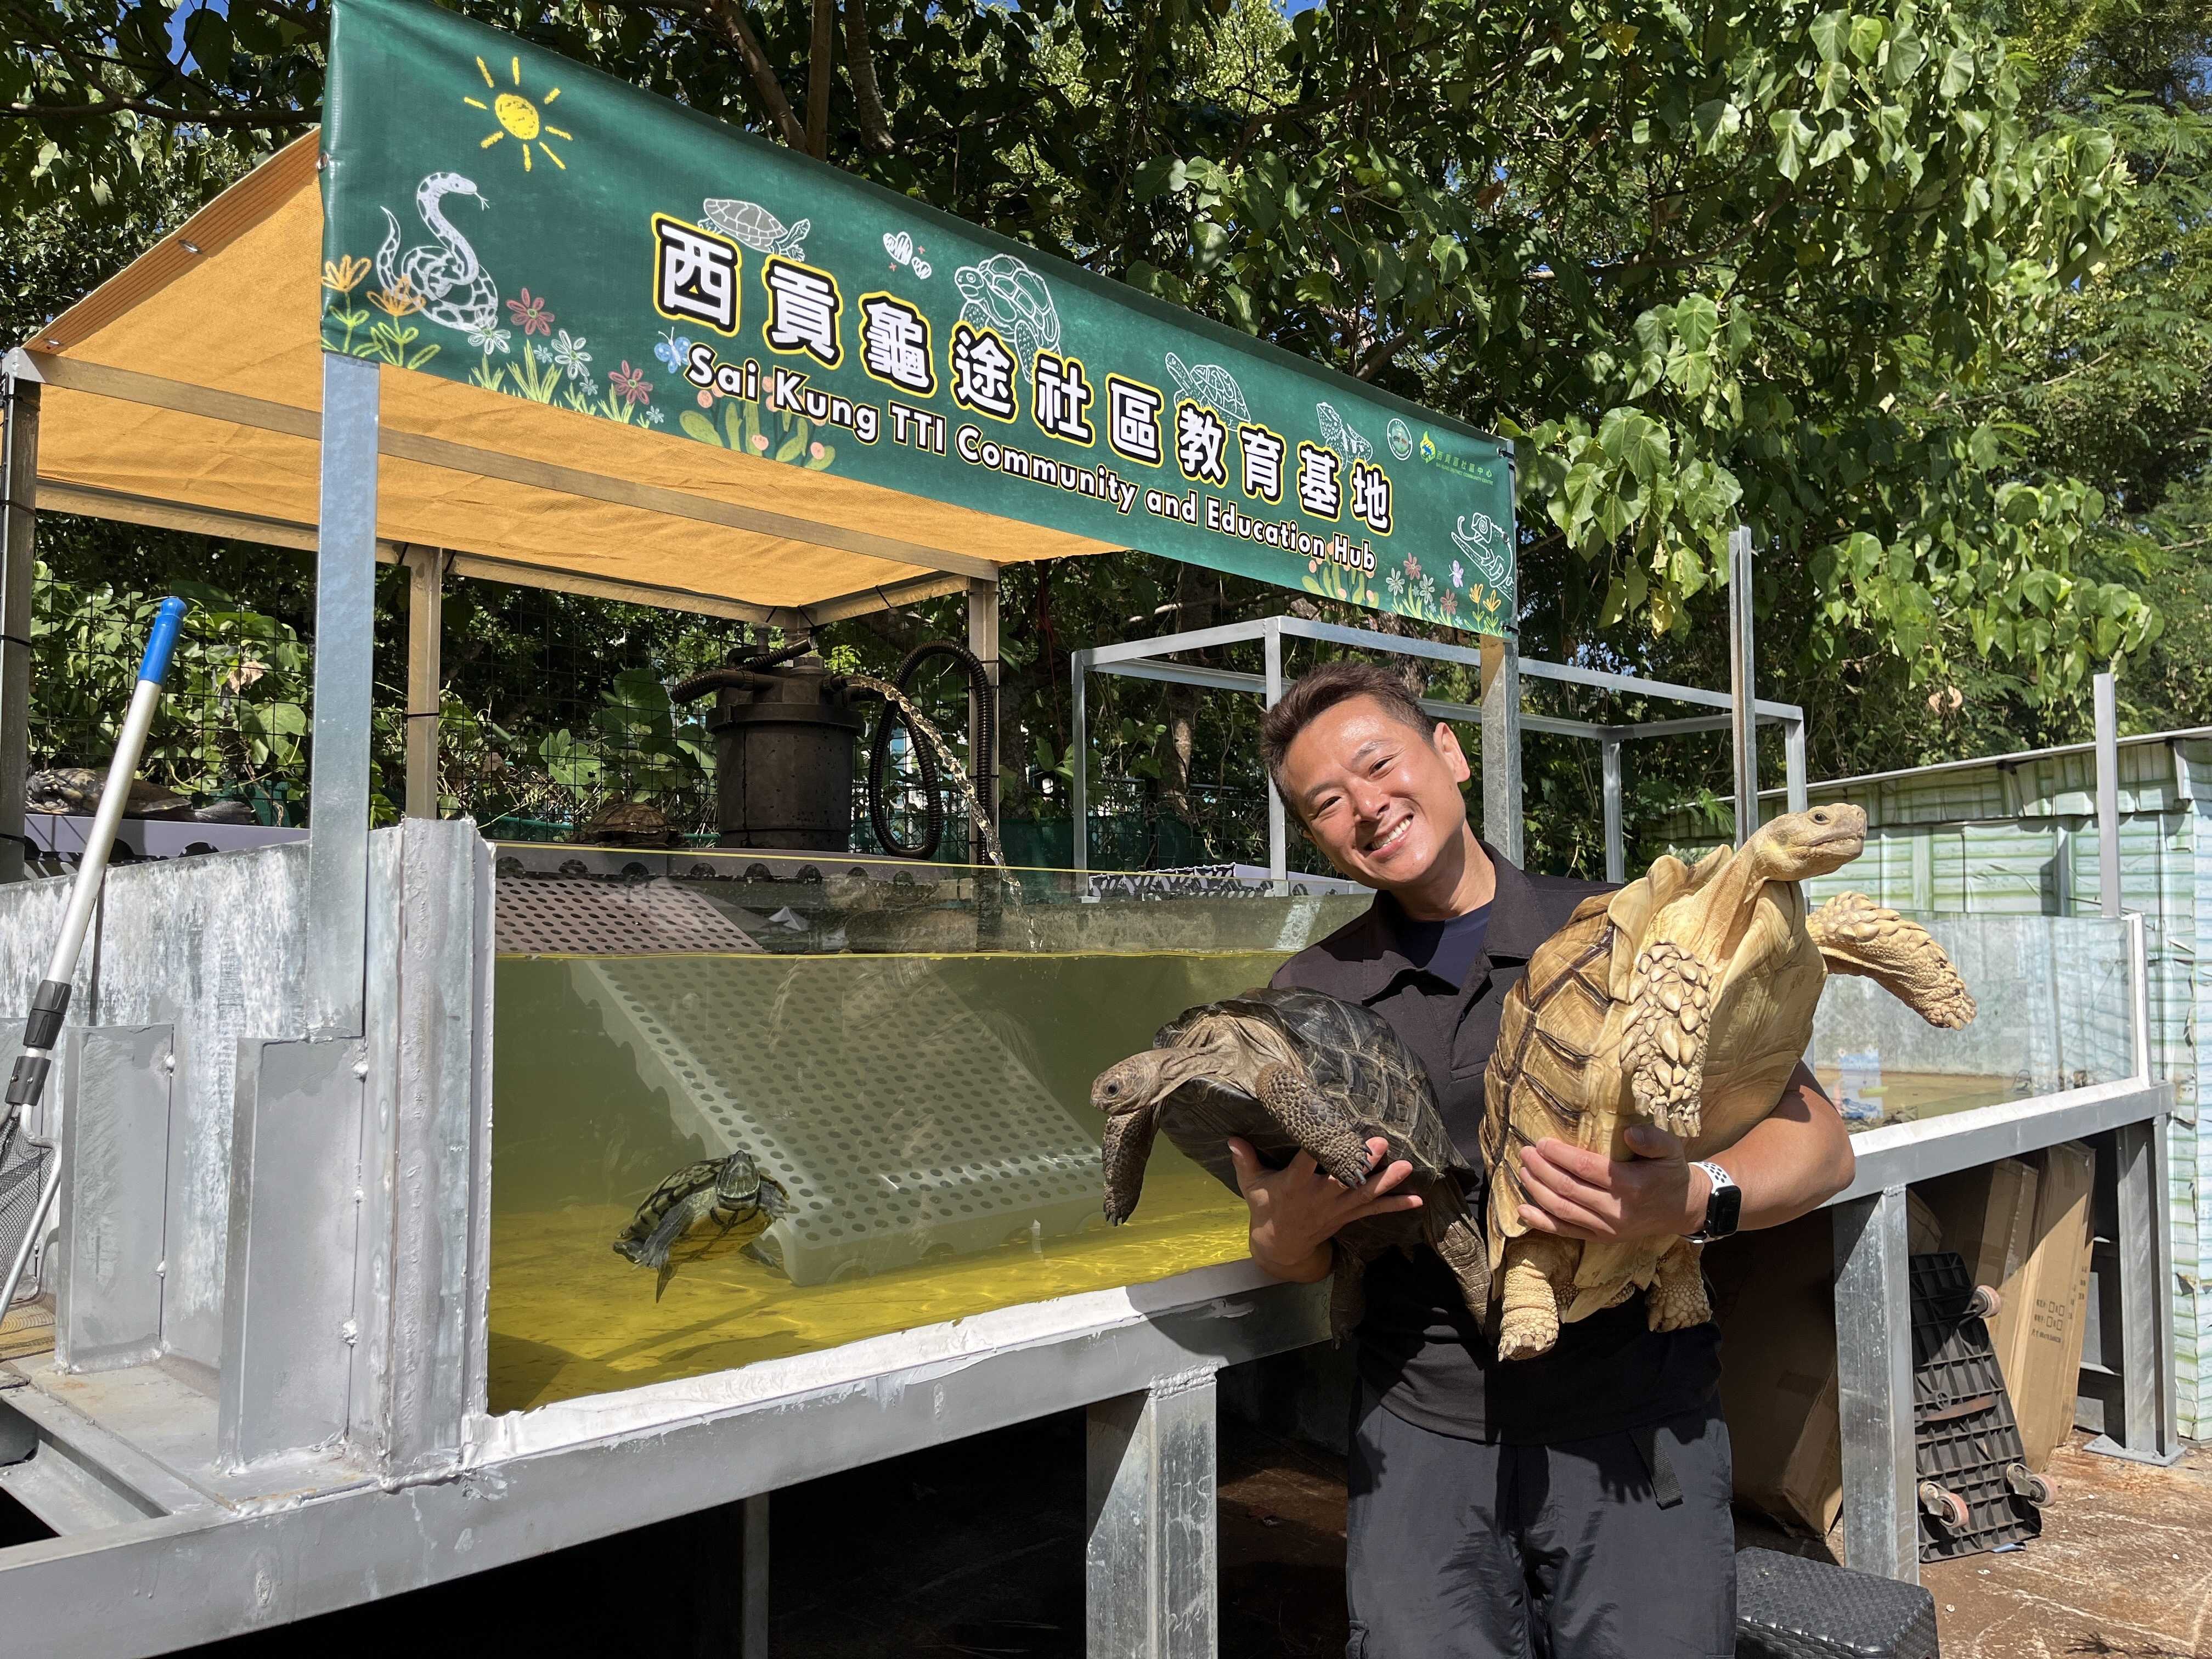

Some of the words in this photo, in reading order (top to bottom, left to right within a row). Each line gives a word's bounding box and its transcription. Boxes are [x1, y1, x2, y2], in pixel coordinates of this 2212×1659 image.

[659, 222, 1390, 531] 西貢龜途社區教育基地
[687, 345, 758, 399] Sai
[775, 369, 878, 442] Kung
[890, 404, 945, 453] TTI
[956, 426, 1138, 513] Community
[1146, 492, 1197, 523] and
[1206, 498, 1325, 558] Education
[1333, 534, 1376, 571] Hub
